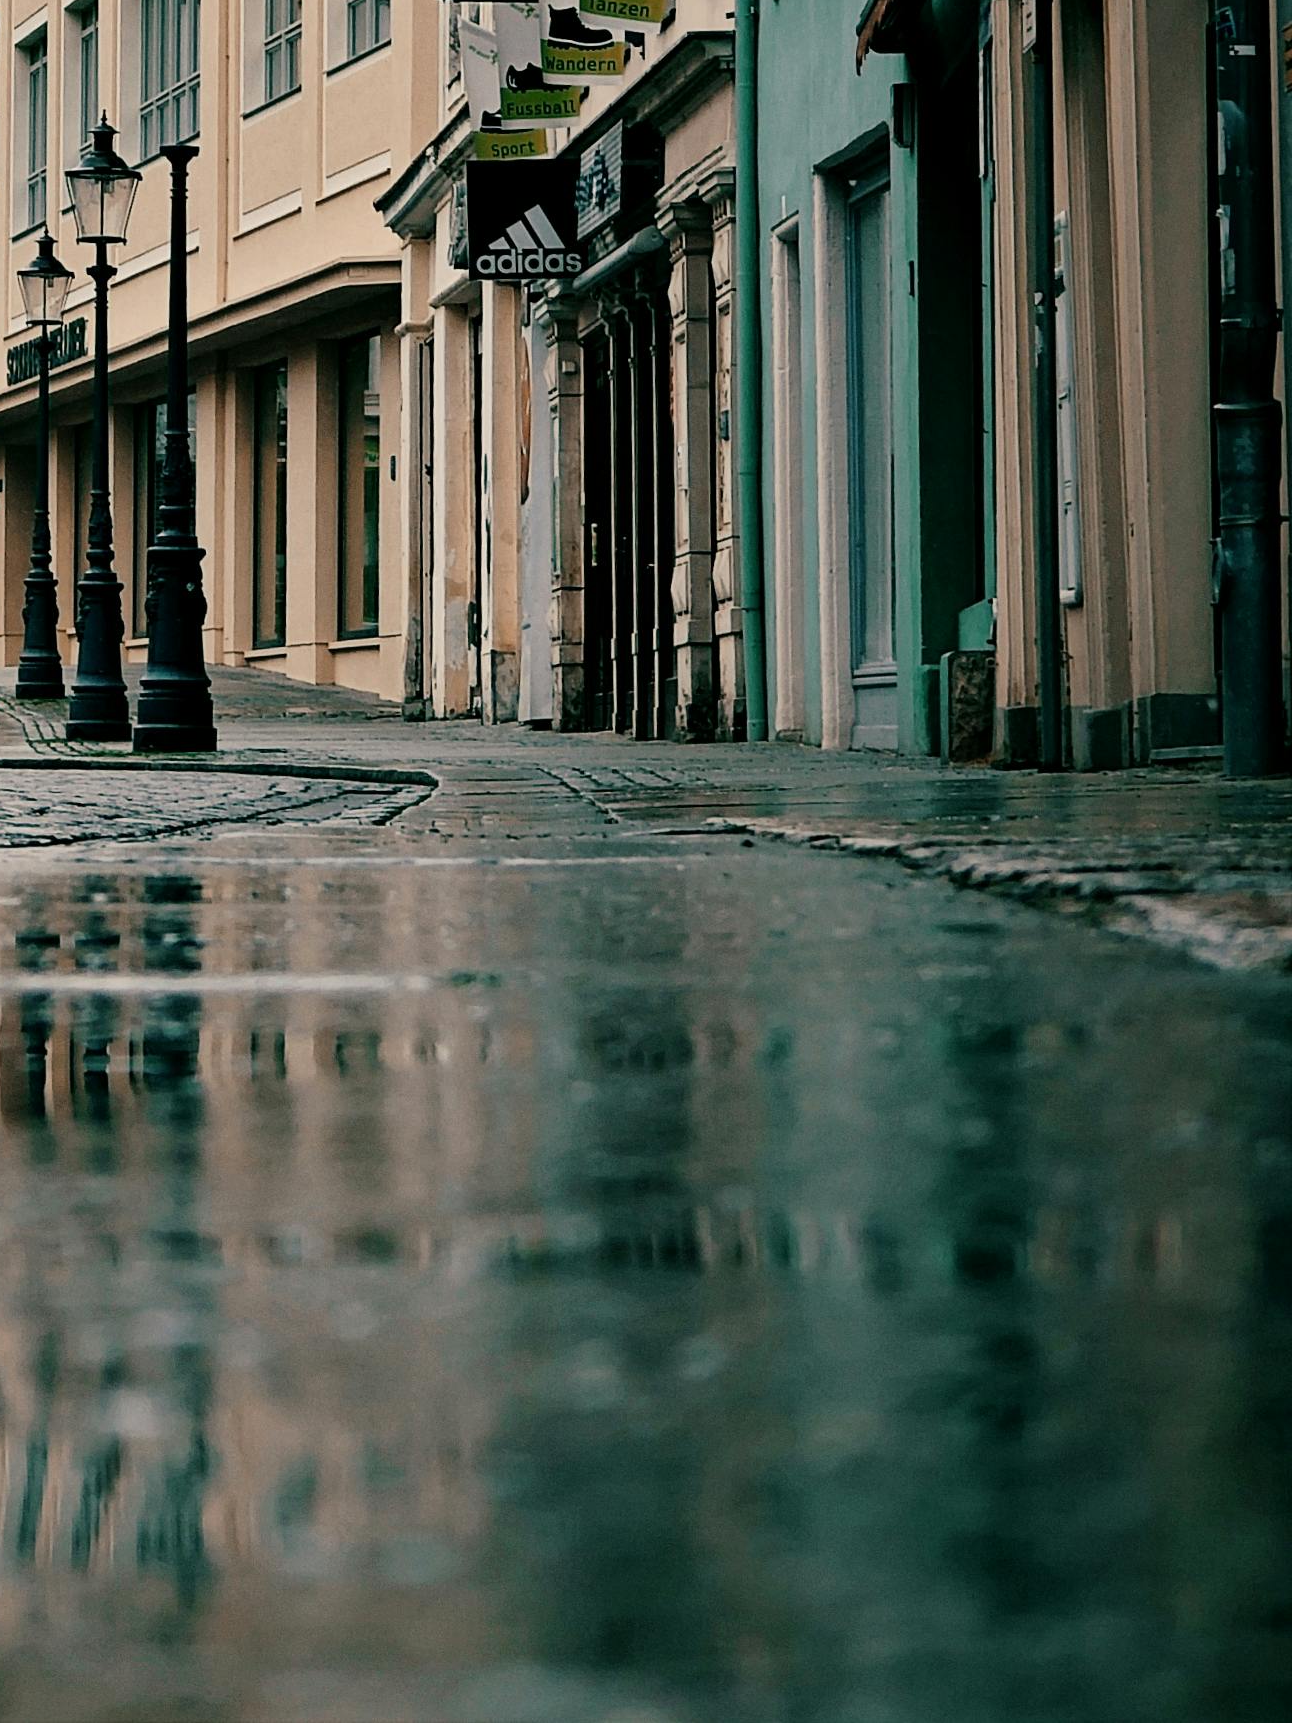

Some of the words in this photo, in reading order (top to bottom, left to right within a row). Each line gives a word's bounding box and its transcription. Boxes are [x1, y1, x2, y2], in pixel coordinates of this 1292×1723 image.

[544, 56, 616, 72] Wandern
[507, 99, 576, 116] Fussball
[491, 141, 536, 158] Sport
[476, 248, 582, 274] adidas
